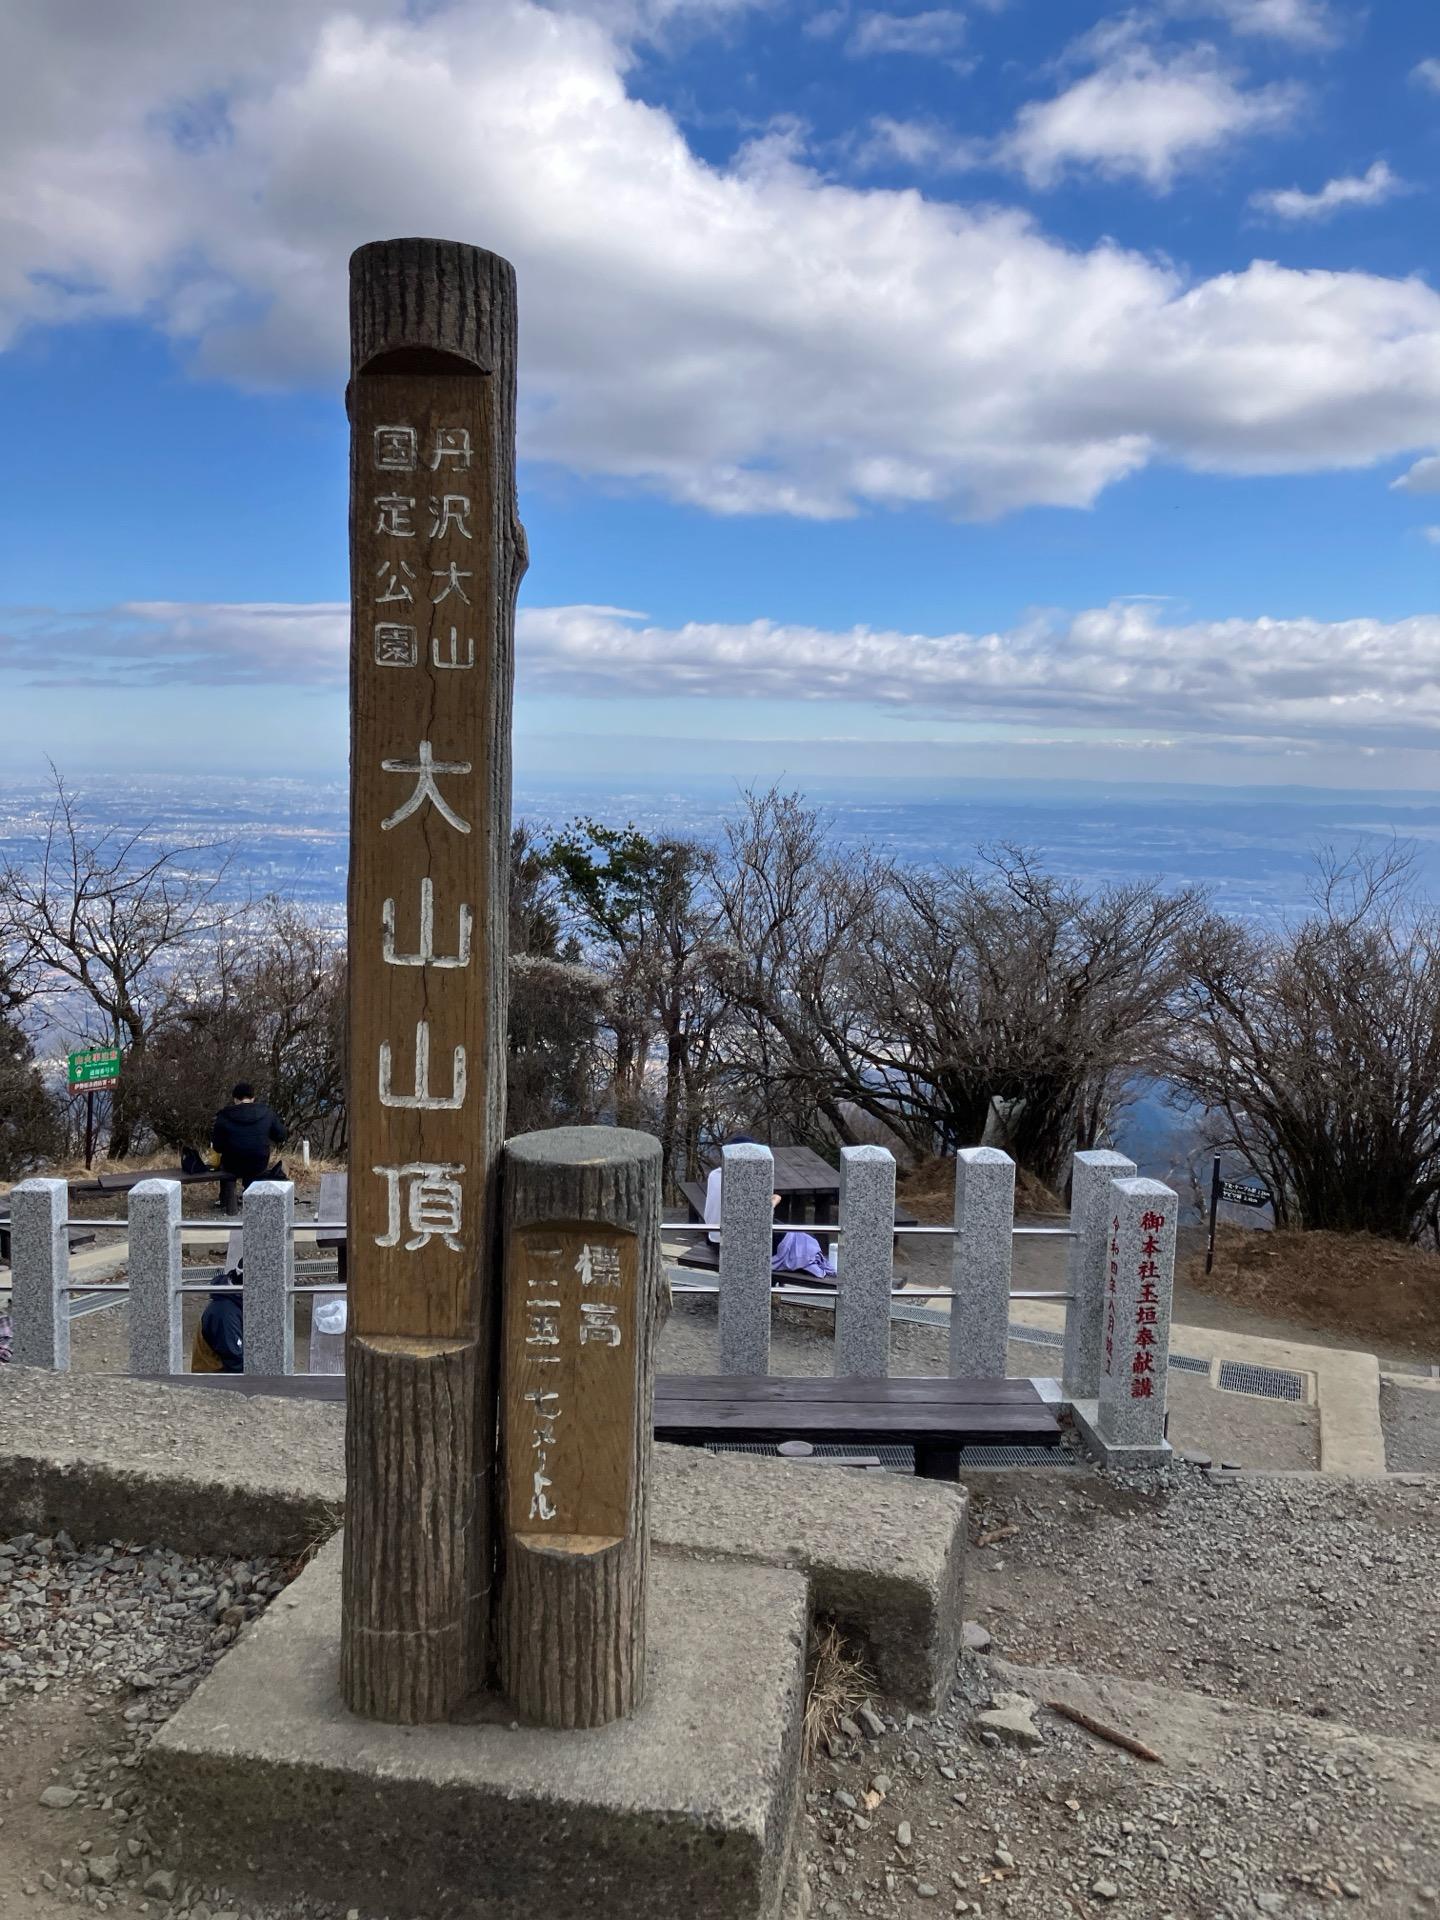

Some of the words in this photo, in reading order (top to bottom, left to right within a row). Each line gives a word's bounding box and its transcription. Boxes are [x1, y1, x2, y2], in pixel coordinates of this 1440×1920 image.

[373, 424, 419, 670] 国定公園
[430, 427, 475, 670] 丹沢大山
[371, 739, 475, 1254] 大山山頂
[574, 1243, 622, 1348] 標高
[1131, 1211, 1165, 1400] 御本社玉垣奉献講
